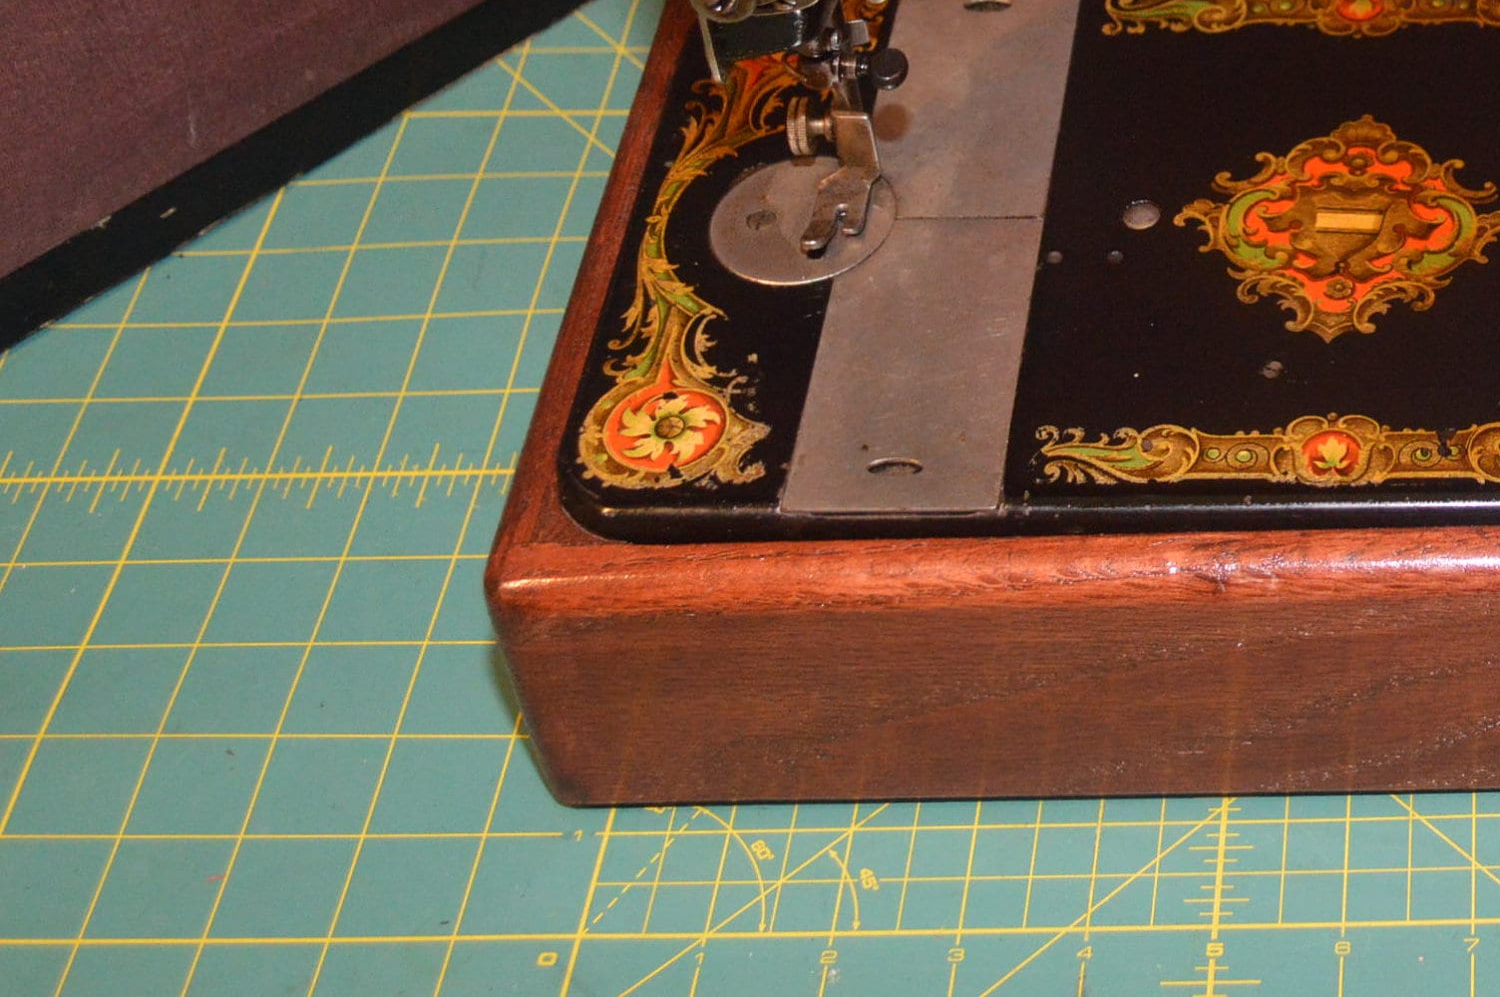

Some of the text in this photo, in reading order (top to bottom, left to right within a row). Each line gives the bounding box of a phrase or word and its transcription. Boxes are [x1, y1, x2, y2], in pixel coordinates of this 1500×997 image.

[1206, 942, 1225, 958] 5
[1334, 940, 1351, 955] 6
[1463, 937, 1481, 952] 7
[819, 950, 838, 965] 2
[946, 947, 966, 963] 3
[1076, 945, 1094, 960] 4
